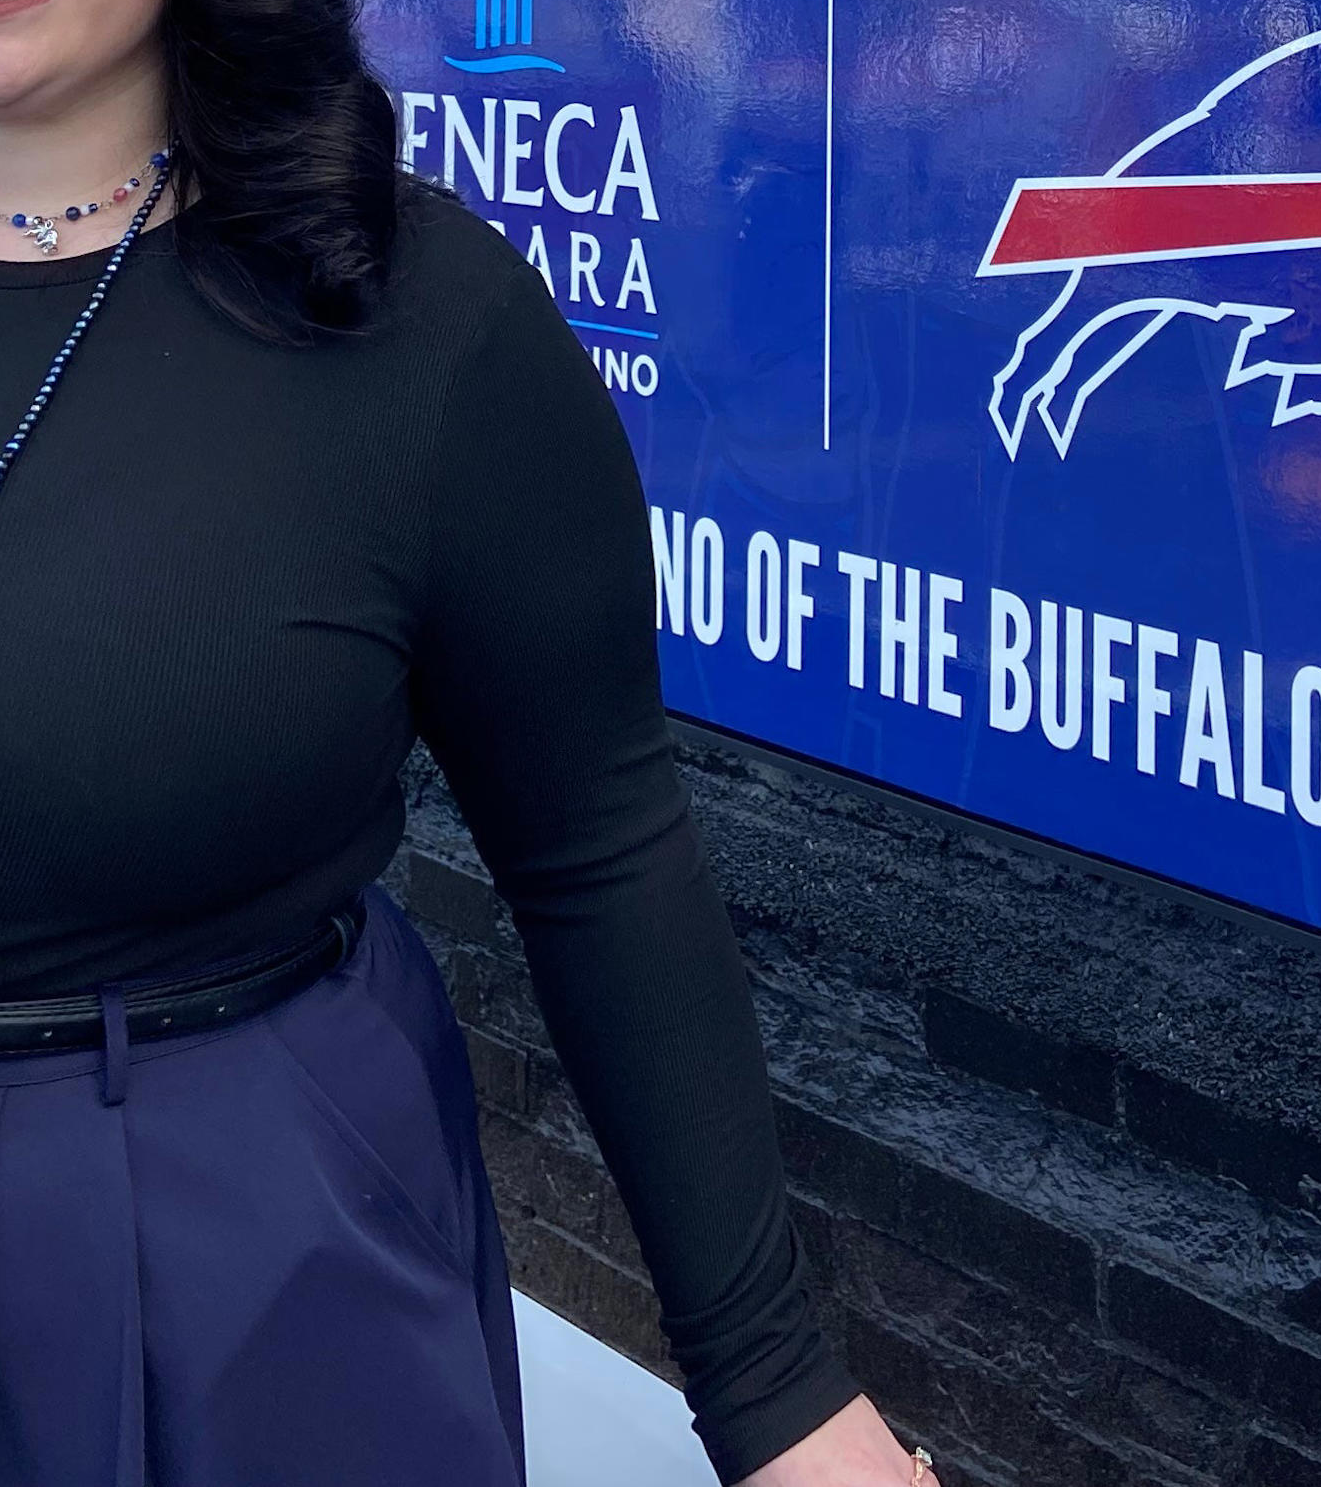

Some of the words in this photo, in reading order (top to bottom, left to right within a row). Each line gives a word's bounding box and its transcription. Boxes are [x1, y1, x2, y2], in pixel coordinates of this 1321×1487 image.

[402, 91, 660, 221] ENECA
[651, 505, 724, 645] NO
[747, 530, 820, 671] OF
[836, 550, 964, 718] THE
